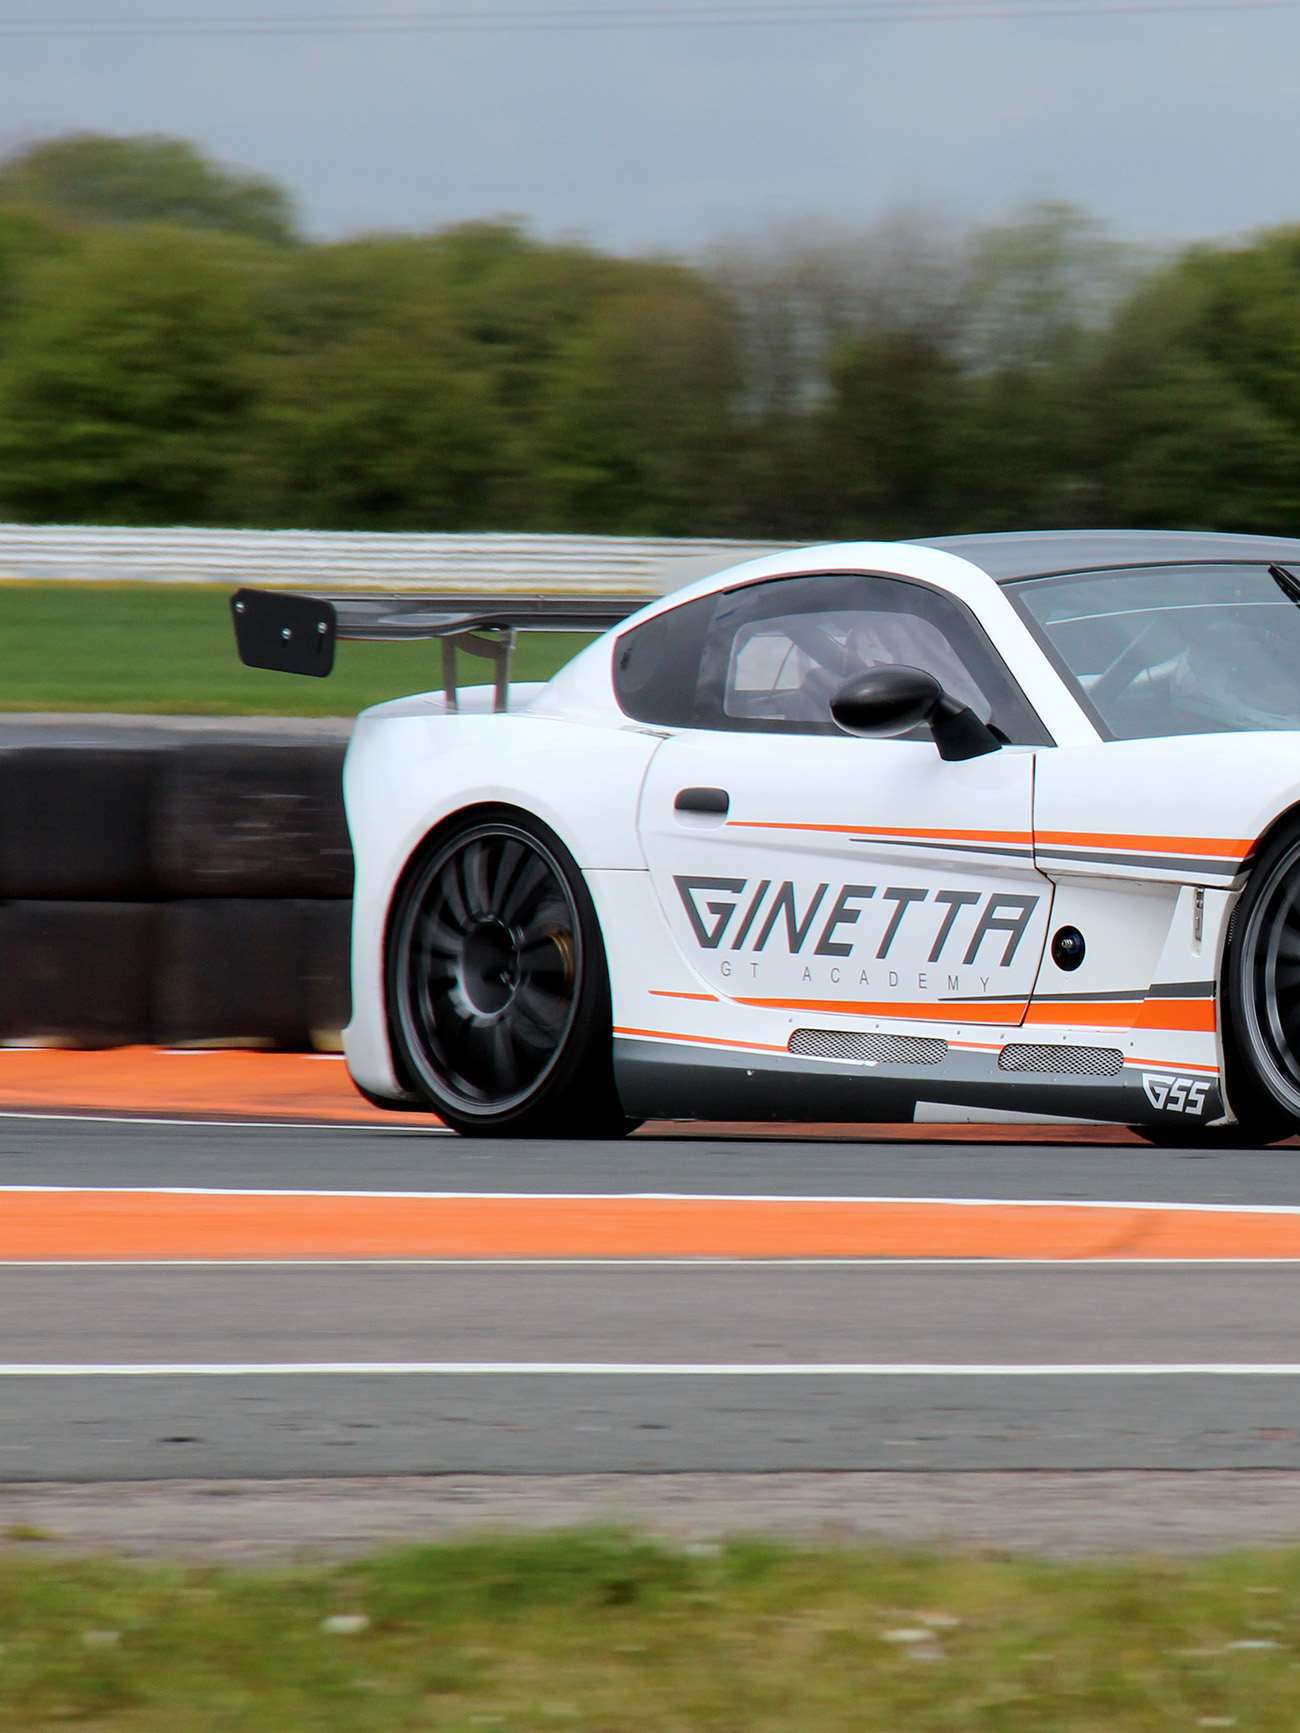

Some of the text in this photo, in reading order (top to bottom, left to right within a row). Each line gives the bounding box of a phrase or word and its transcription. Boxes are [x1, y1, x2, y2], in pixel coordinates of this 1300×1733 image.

[672, 874, 1041, 968] GINETTA
[720, 961, 991, 993] GT ACADEMY
